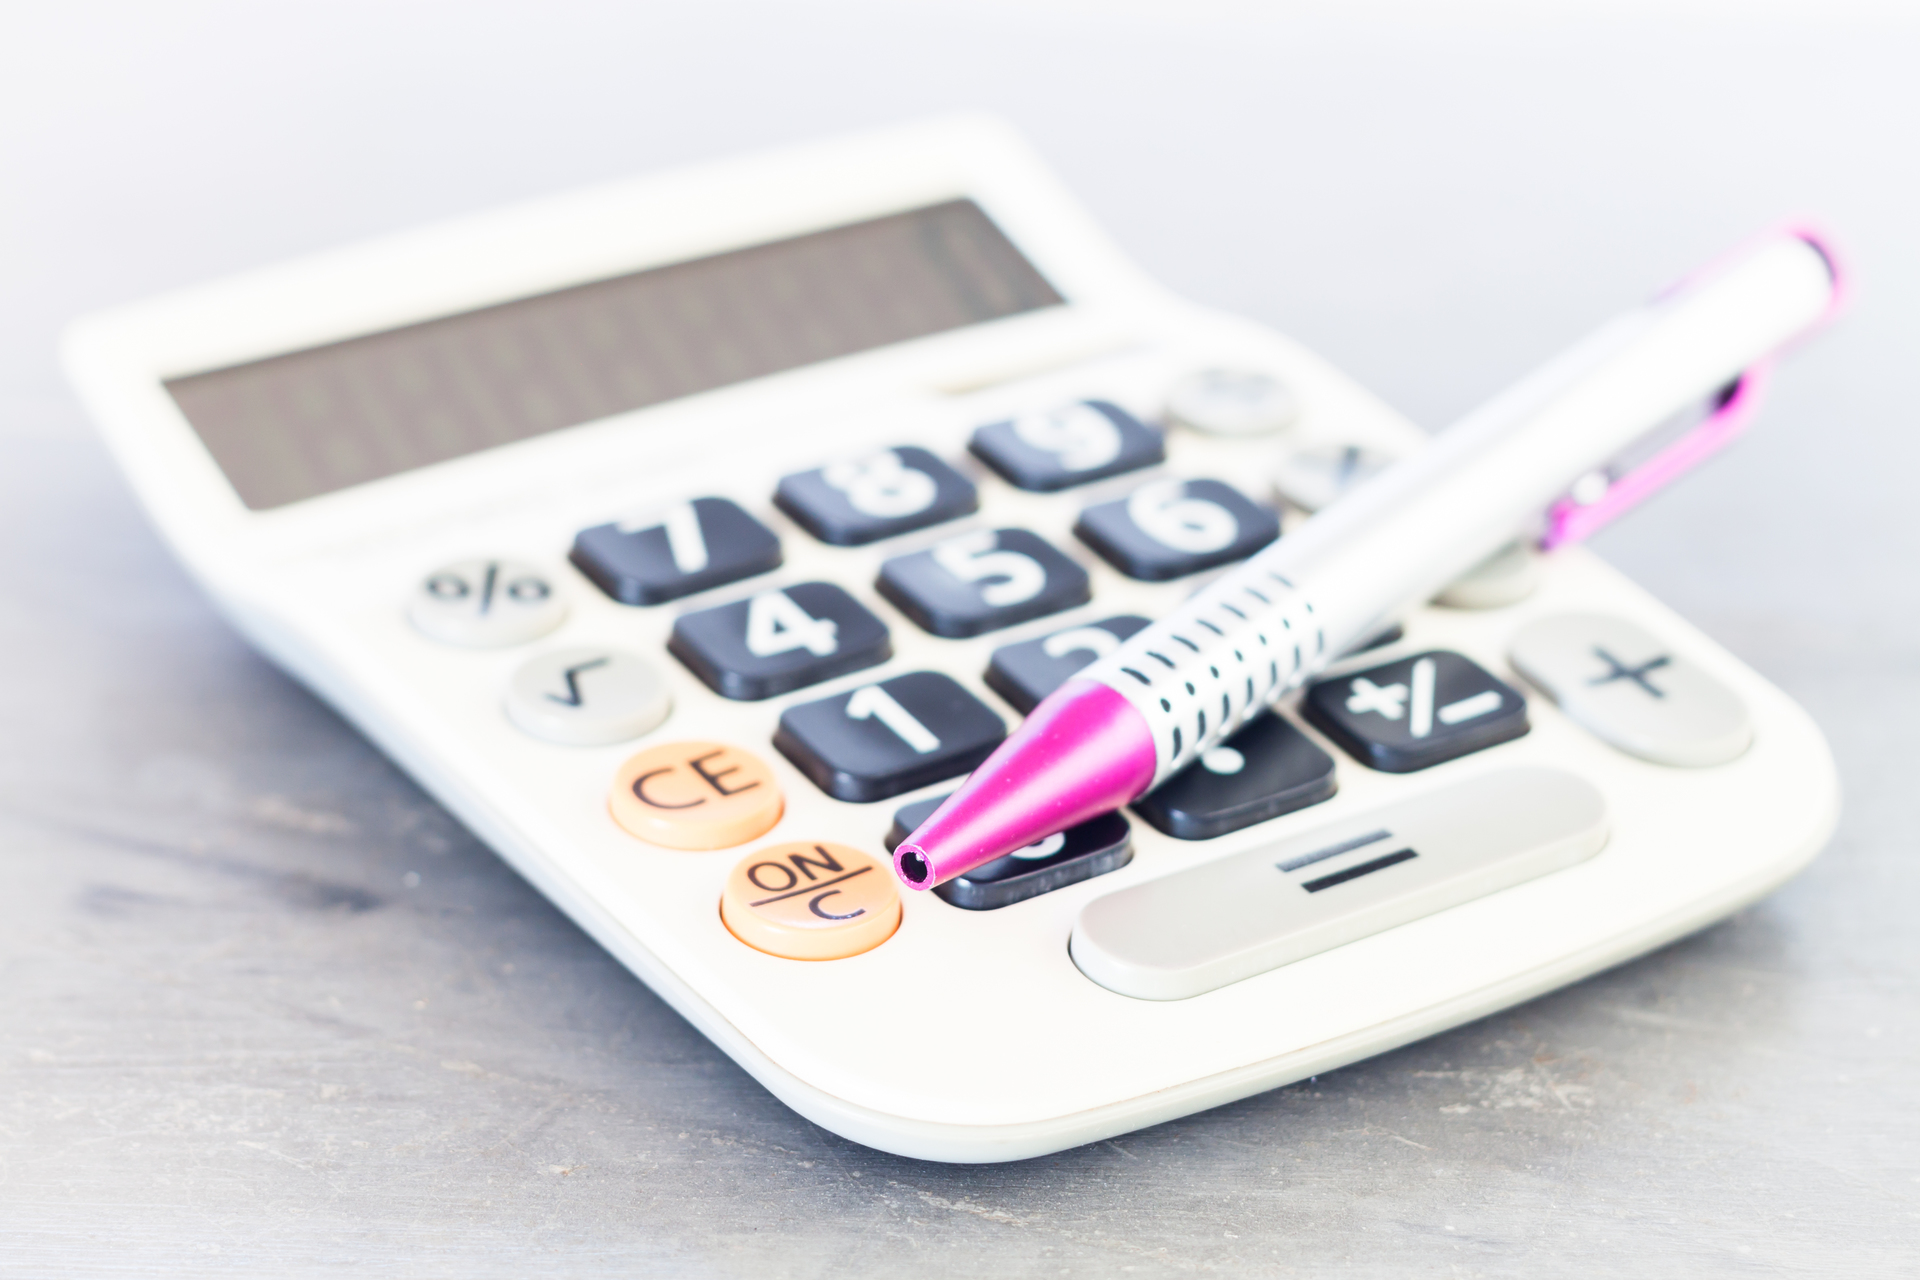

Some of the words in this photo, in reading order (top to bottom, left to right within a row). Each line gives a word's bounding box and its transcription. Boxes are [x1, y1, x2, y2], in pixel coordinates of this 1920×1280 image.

[820, 447, 938, 518] 8
[1128, 478, 1239, 553] 6
[614, 498, 709, 575] 7
[932, 530, 1046, 606] 5
[746, 590, 839, 657] 4
[846, 685, 942, 754] 1
[632, 750, 761, 810] CE
[747, 845, 845, 892] ON
[808, 889, 866, 920] C
